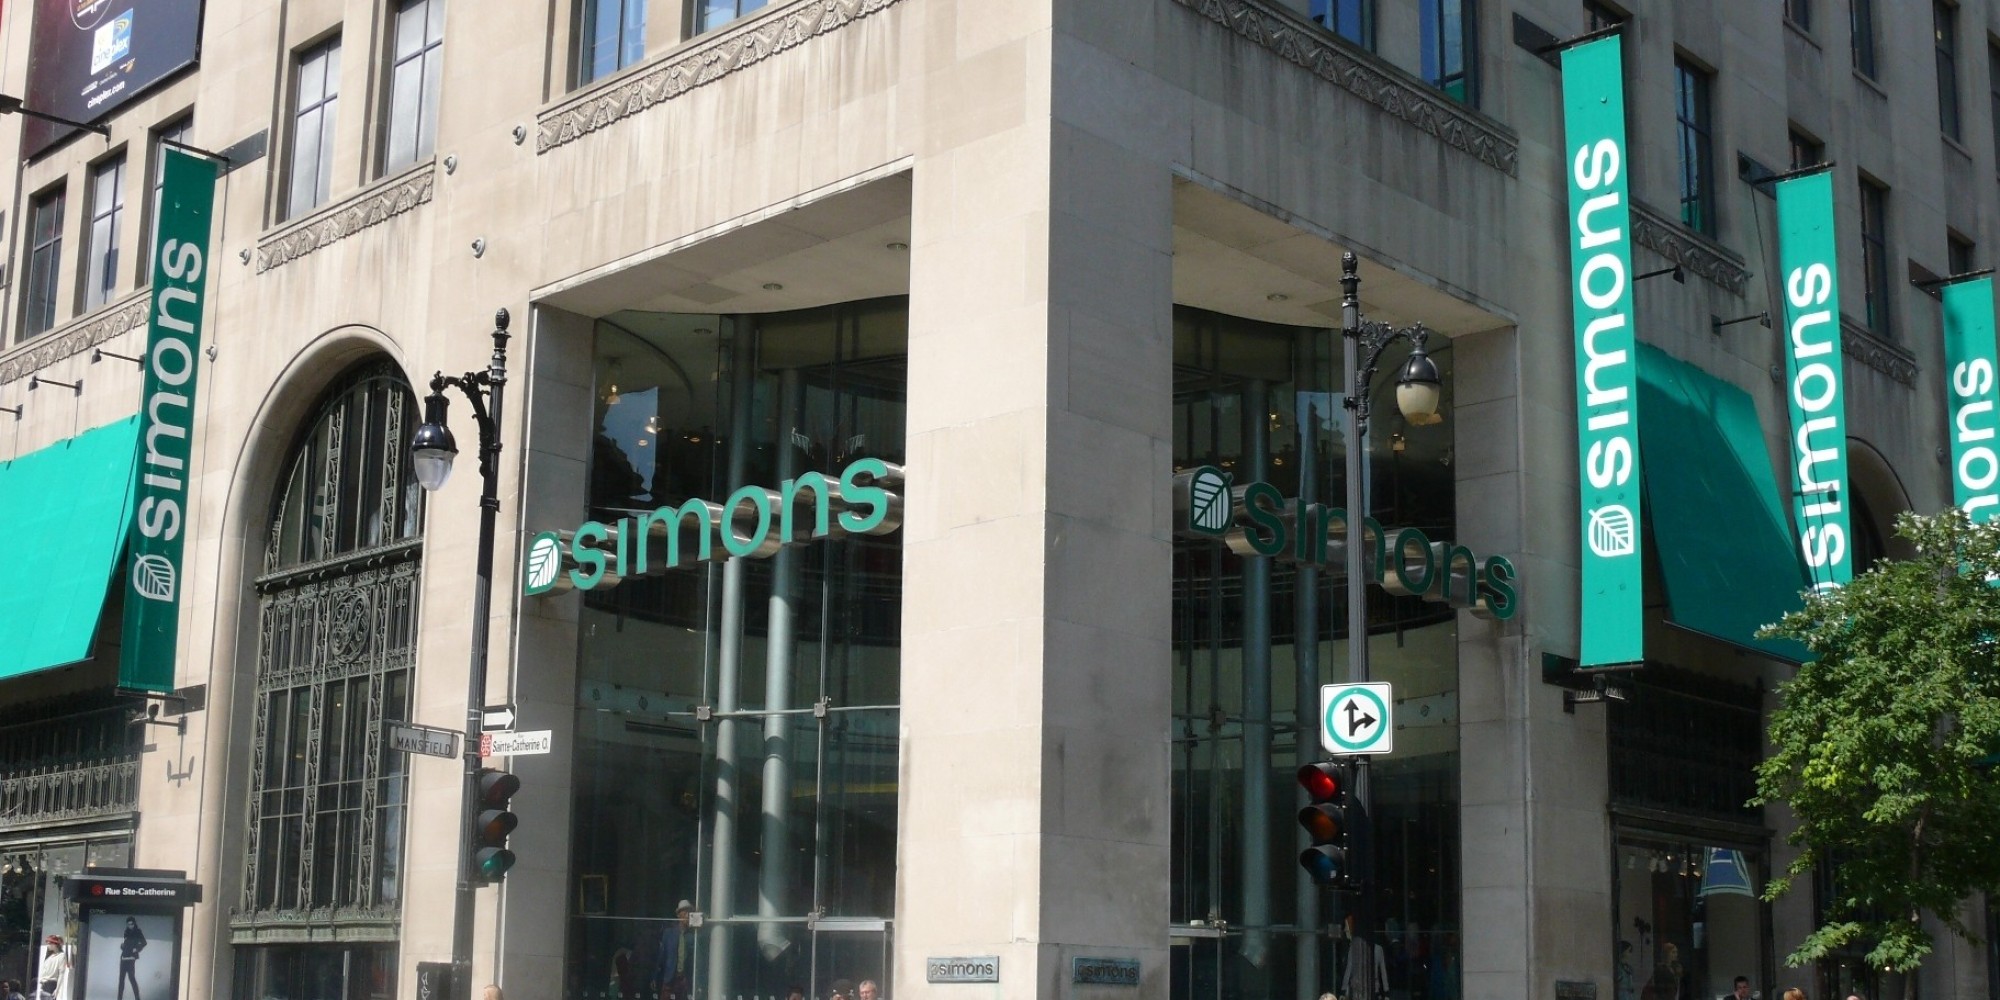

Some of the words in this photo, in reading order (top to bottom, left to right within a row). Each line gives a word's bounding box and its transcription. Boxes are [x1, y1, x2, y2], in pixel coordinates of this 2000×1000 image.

[87, 80, 125, 109] cineplex.com
[1574, 138, 1632, 488] simons
[138, 238, 202, 541] simons
[1788, 262, 1845, 567] simons
[569, 457, 889, 591] simons
[1244, 481, 1517, 620] simons
[396, 735, 451, 756] MANSFIELD
[492, 738, 540, 752] Sainte-Catherine
[105, 887, 120, 895] Rue
[122, 887, 176, 896] Ste-Catherine
[939, 963, 993, 976] simons
